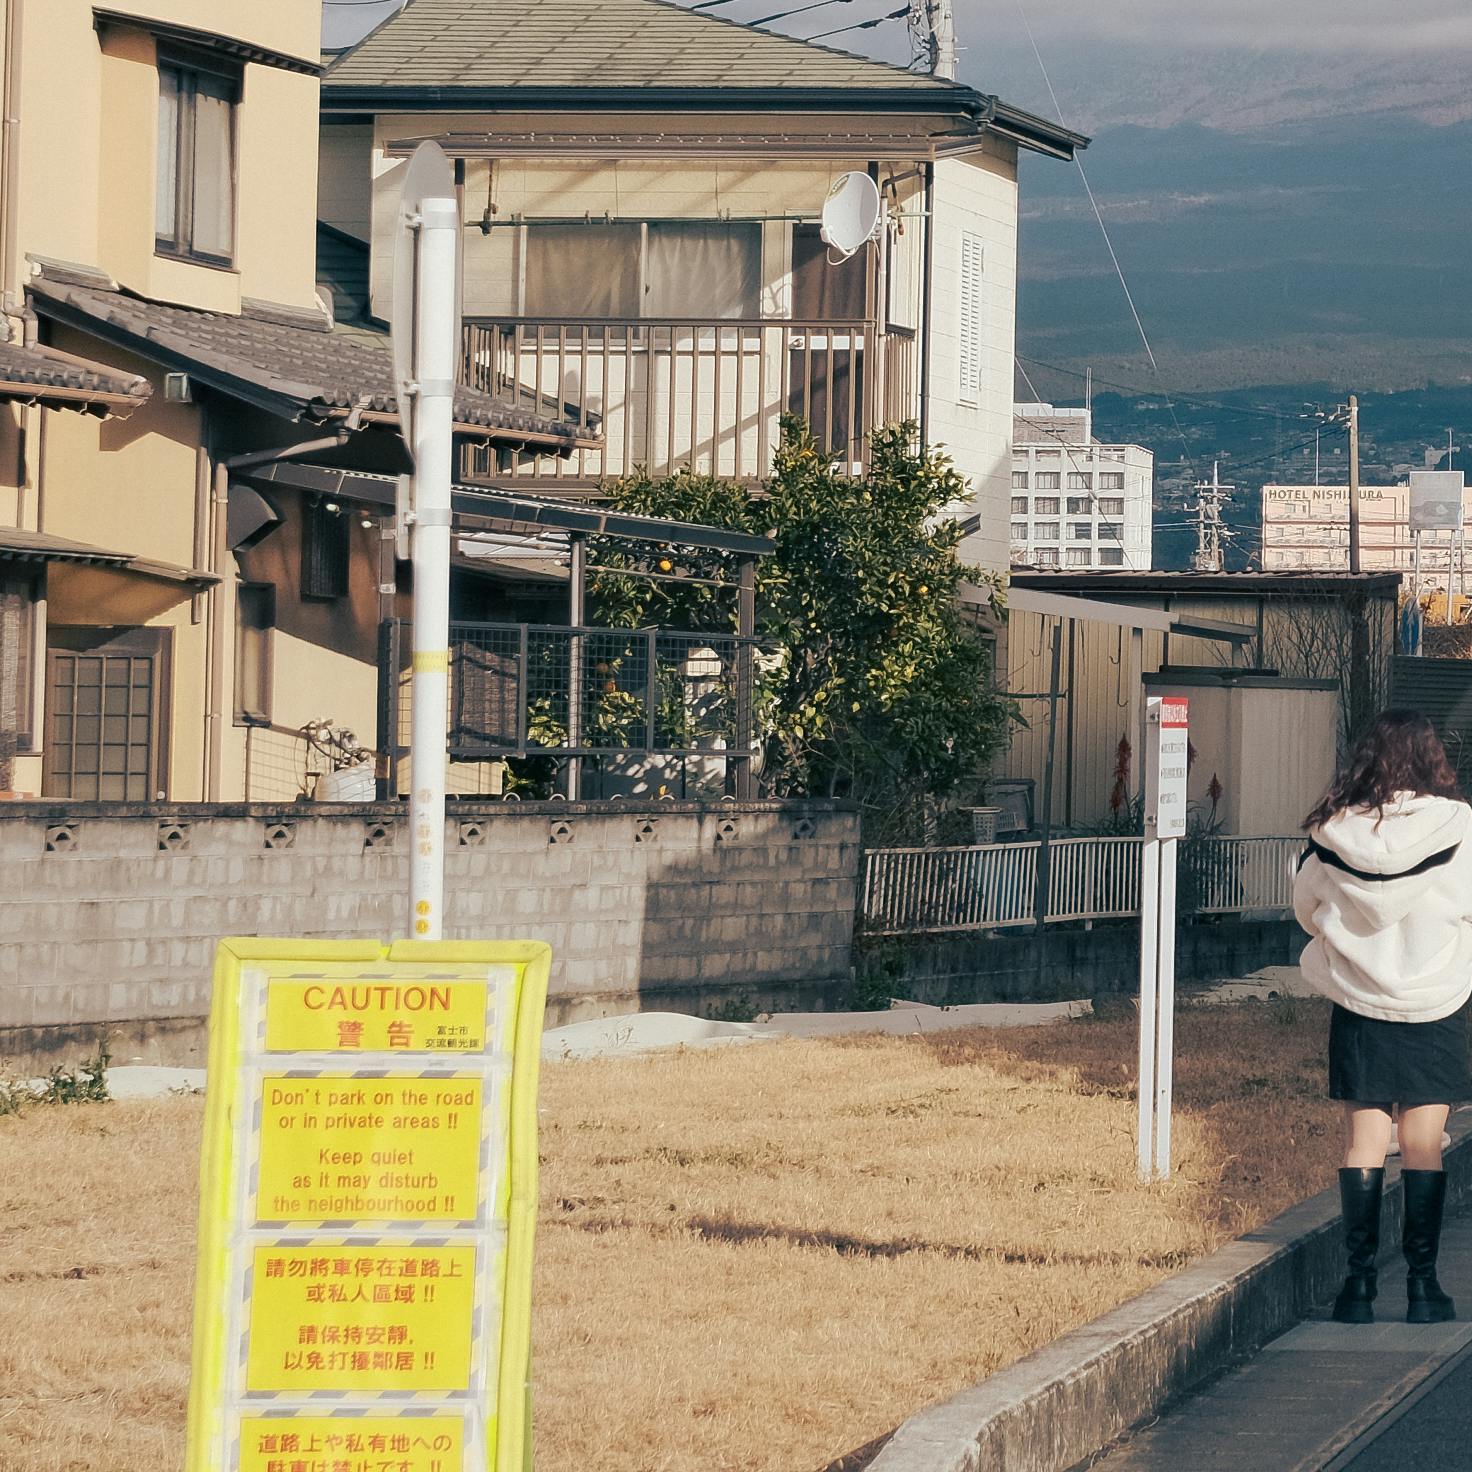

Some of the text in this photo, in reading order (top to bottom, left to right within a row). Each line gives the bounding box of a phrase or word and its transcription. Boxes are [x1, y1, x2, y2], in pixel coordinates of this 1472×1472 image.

[1268, 489, 1384, 500] HOTEL NISHIURA
[304, 986, 451, 1011] CAUTION
[329, 1089, 365, 1106] park
[372, 1093, 393, 1105] on
[402, 1089, 428, 1105] the
[436, 1090, 474, 1105] road
[279, 1116, 296, 1128] or
[304, 1113, 317, 1128] in
[325, 1113, 384, 1130] private
[393, 1116, 440, 1129] areas
[320, 1149, 414, 1166] Keep quiet
[293, 1173, 438, 1189] as it may disturb
[274, 1196, 300, 1211] the
[308, 1196, 436, 1213] neighbourhood
[266, 1257, 462, 1278] 請勿將車停在道路上
[306, 1283, 415, 1304] 或私人區域
[258, 1433, 452, 1455] 道路上や私有地への
